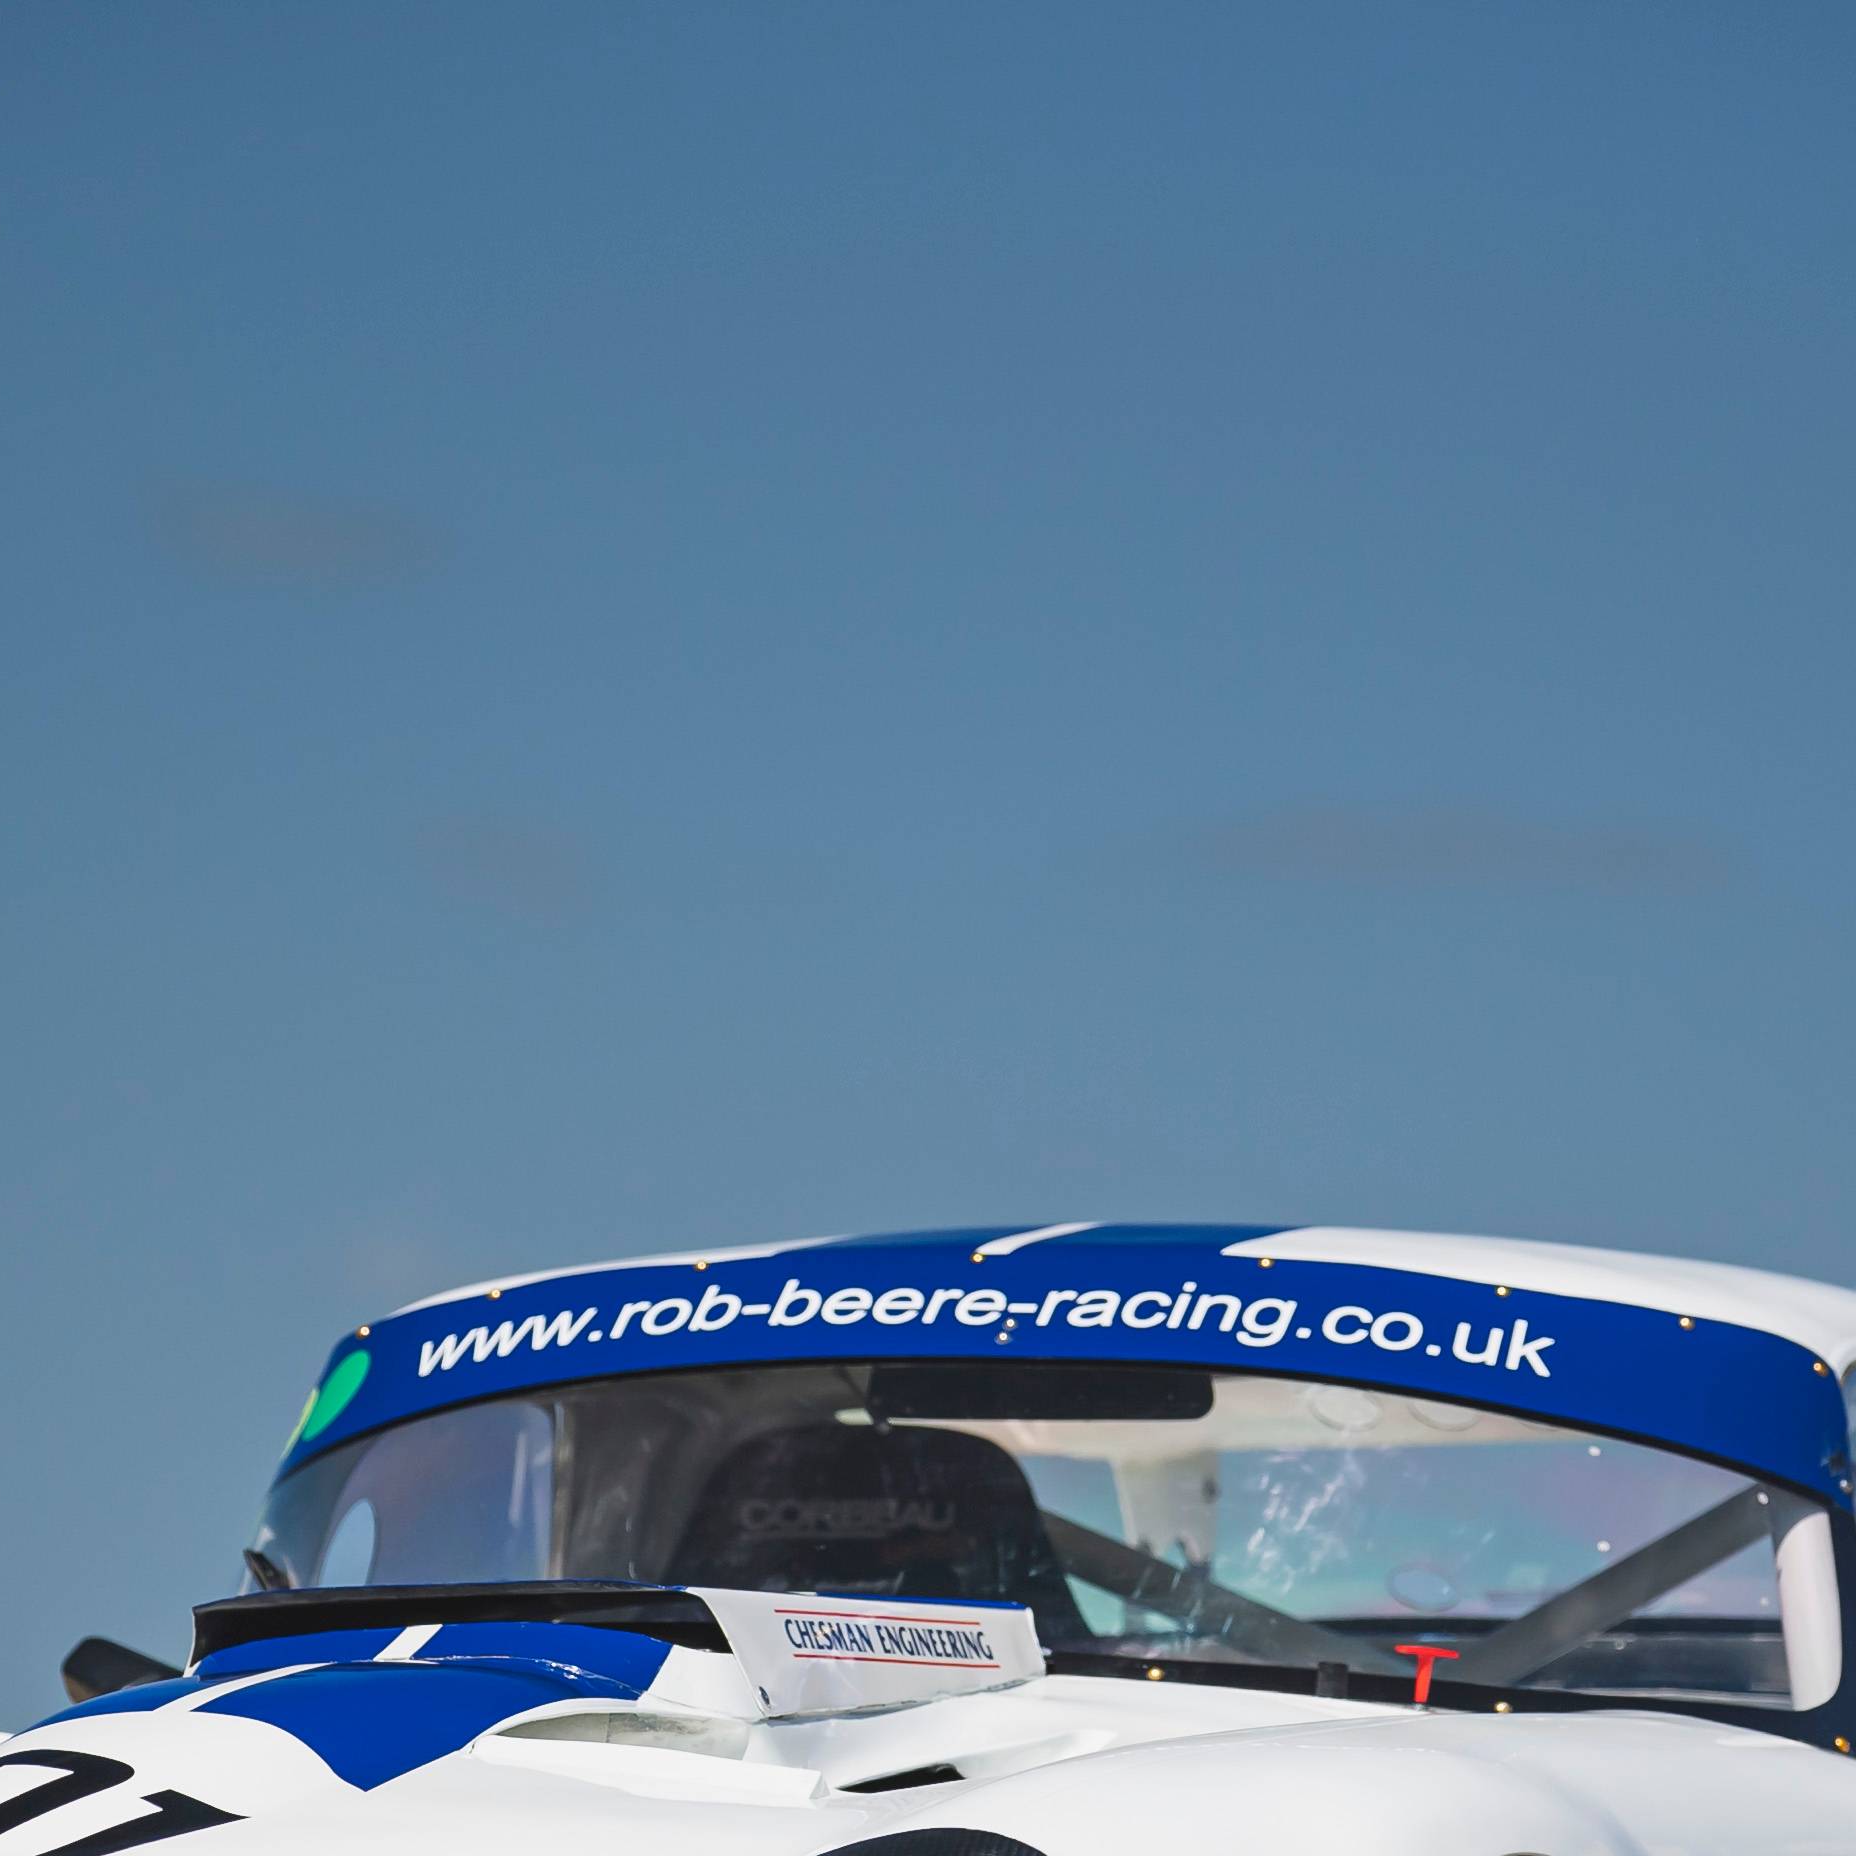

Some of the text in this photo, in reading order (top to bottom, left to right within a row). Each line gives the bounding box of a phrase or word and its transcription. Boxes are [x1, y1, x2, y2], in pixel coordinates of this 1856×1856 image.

[417, 1279, 1556, 1379] www.rob-beere-racing.co.uk
[784, 1618, 994, 1661] CHESMAN ENGINEERING
